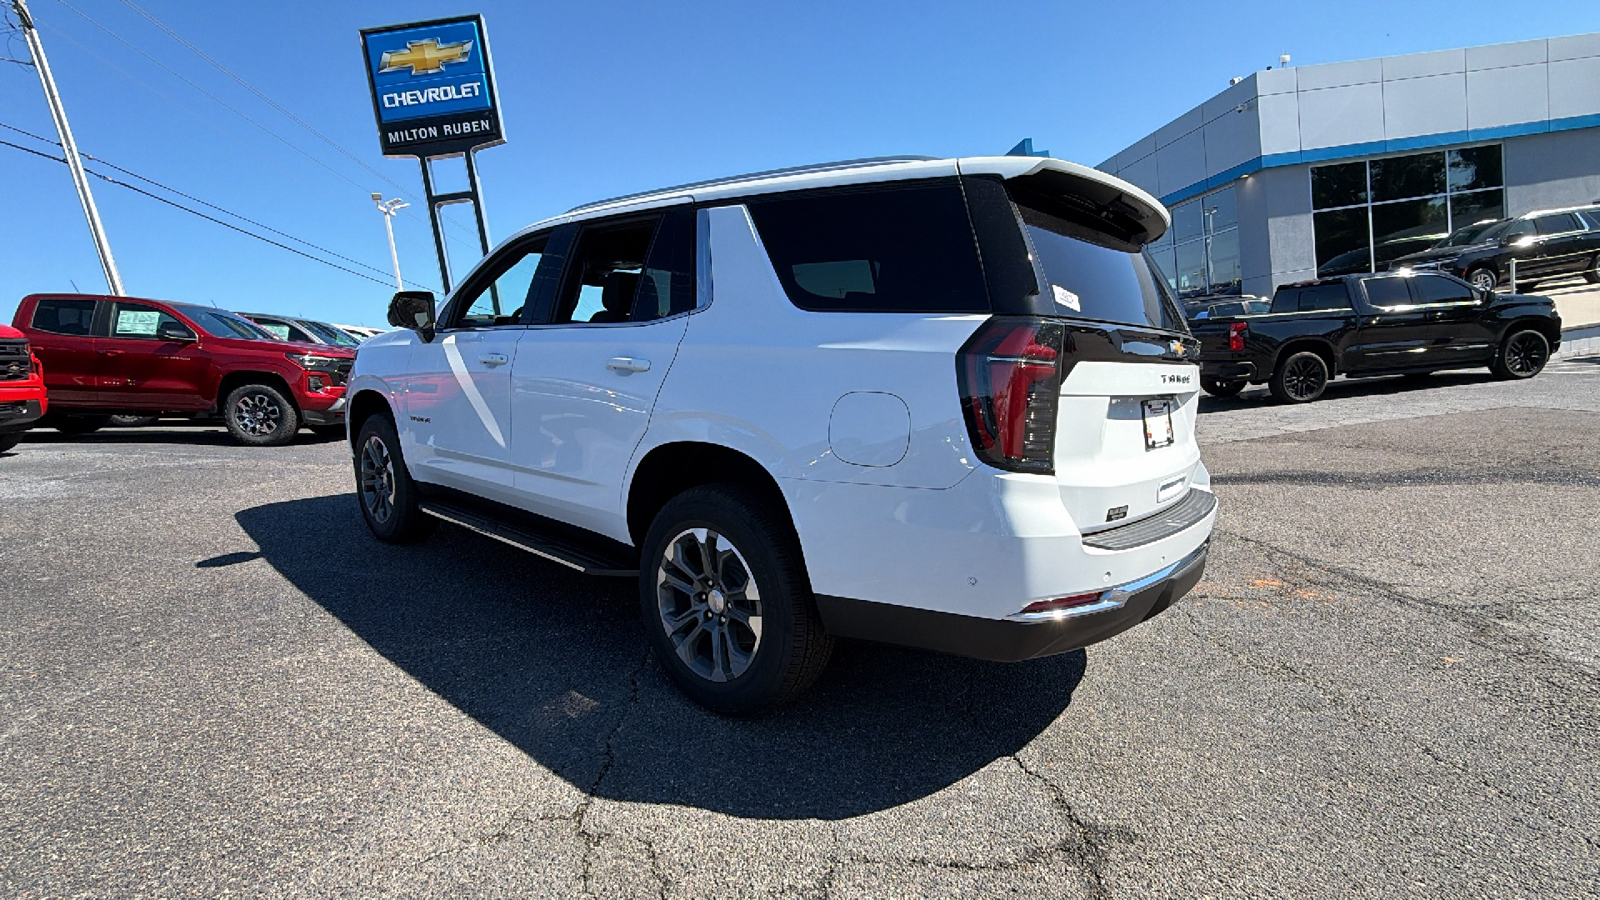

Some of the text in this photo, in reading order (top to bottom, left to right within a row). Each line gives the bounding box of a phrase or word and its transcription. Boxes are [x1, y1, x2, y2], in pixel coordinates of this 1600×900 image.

[382, 82, 481, 108] CHEVROLET
[388, 119, 490, 144] MILTON RUBEN
